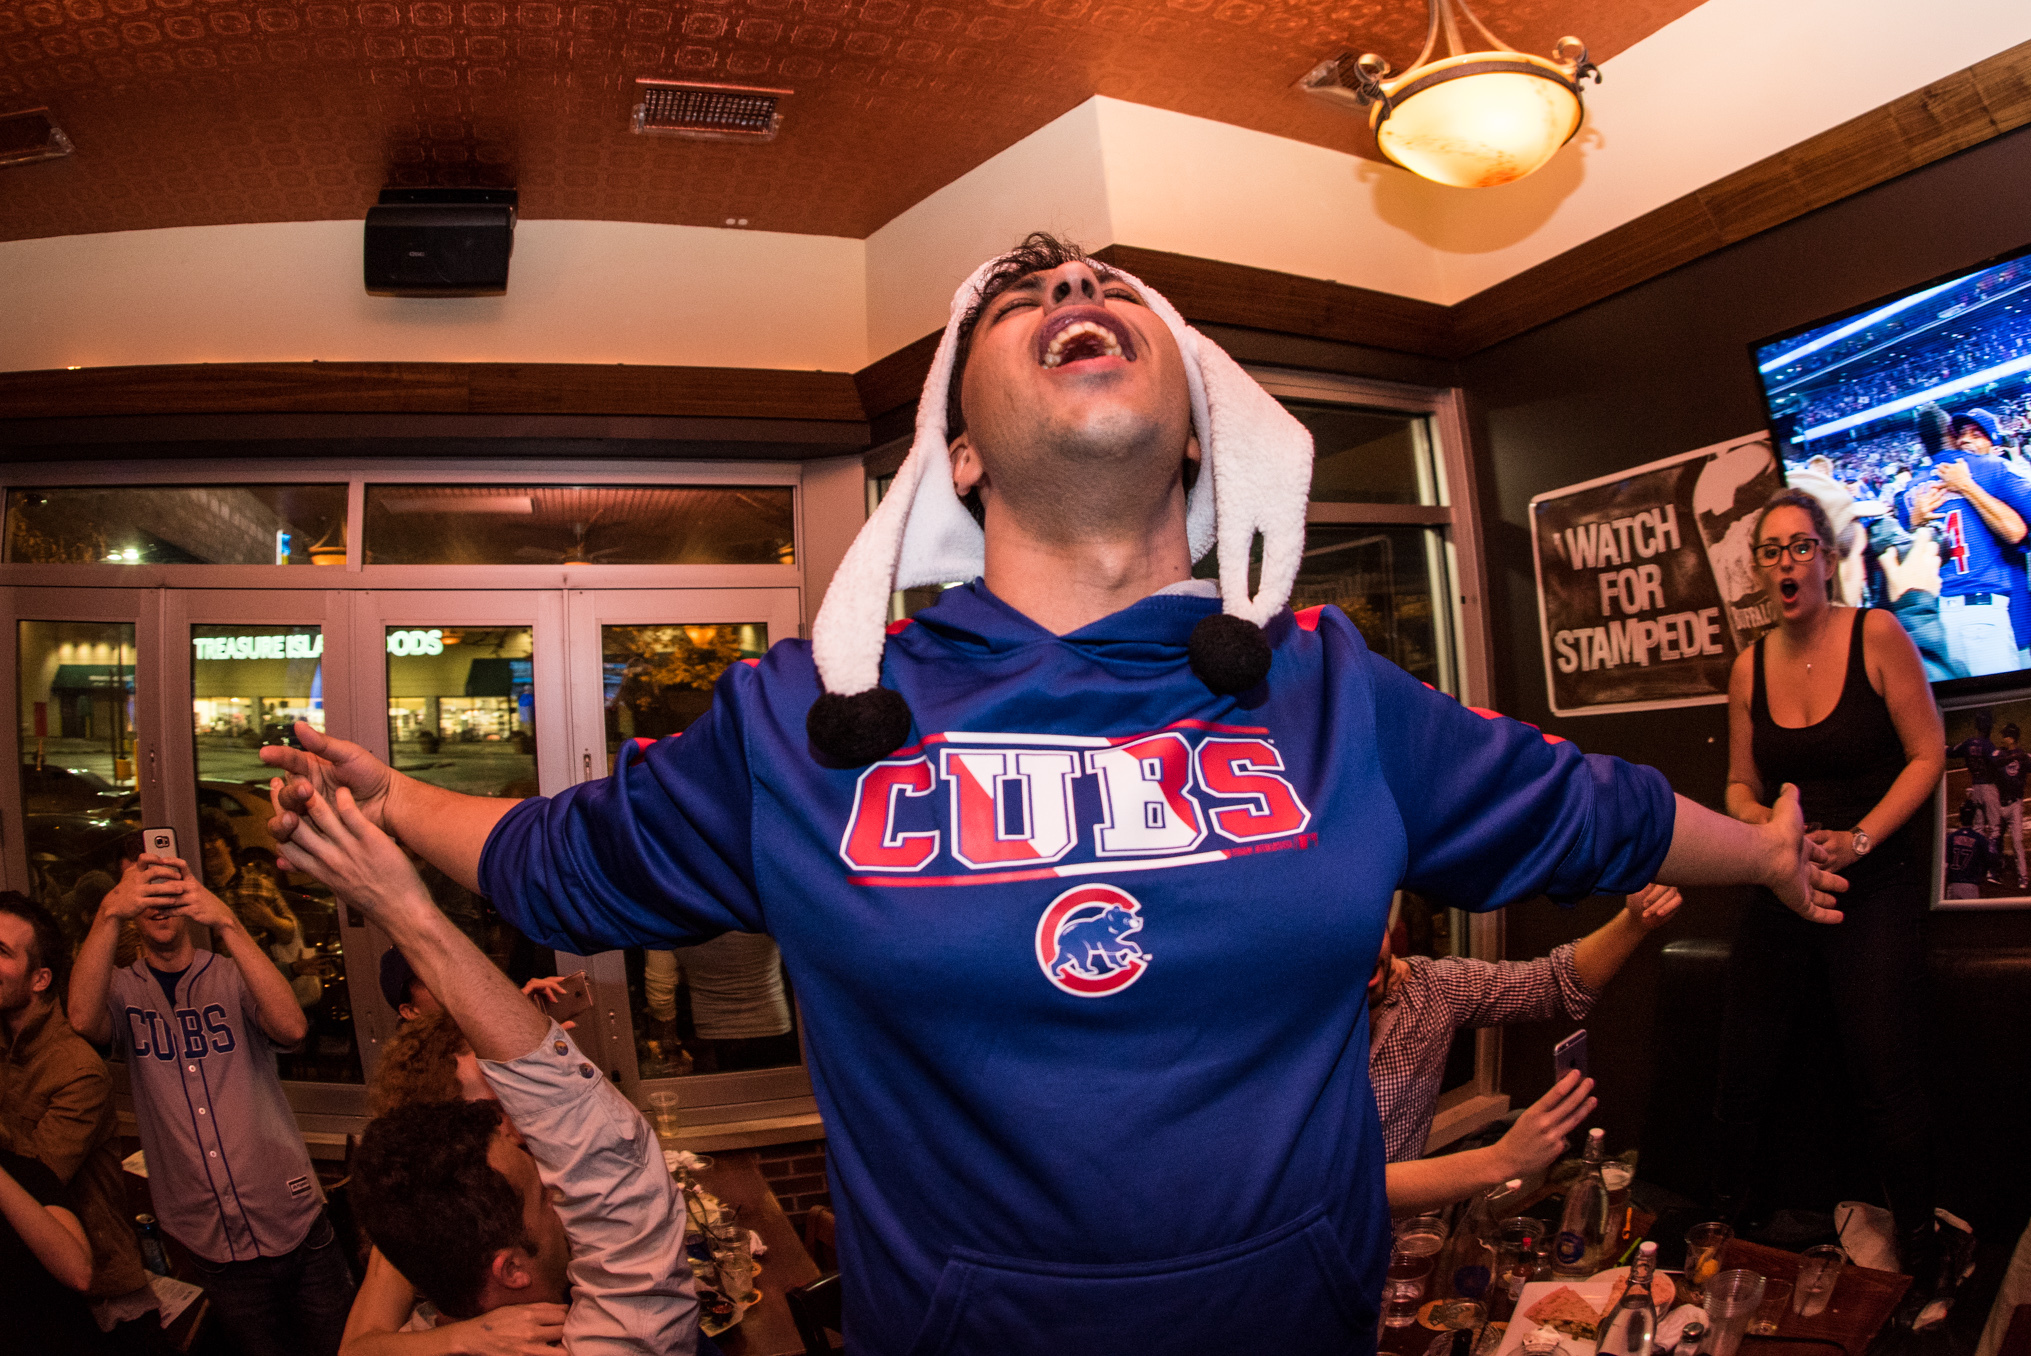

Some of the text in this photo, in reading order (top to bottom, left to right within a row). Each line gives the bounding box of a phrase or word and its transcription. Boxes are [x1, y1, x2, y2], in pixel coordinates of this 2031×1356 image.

[1565, 503, 1681, 571] WATCH
[1598, 563, 1666, 616] FOR
[193, 635, 285, 660] TREASURE
[285, 634, 324, 659] ISLA
[1553, 606, 1724, 674] STAMPEDE
[840, 732, 1311, 871] CUBS
[125, 1002, 236, 1062] CUBS
